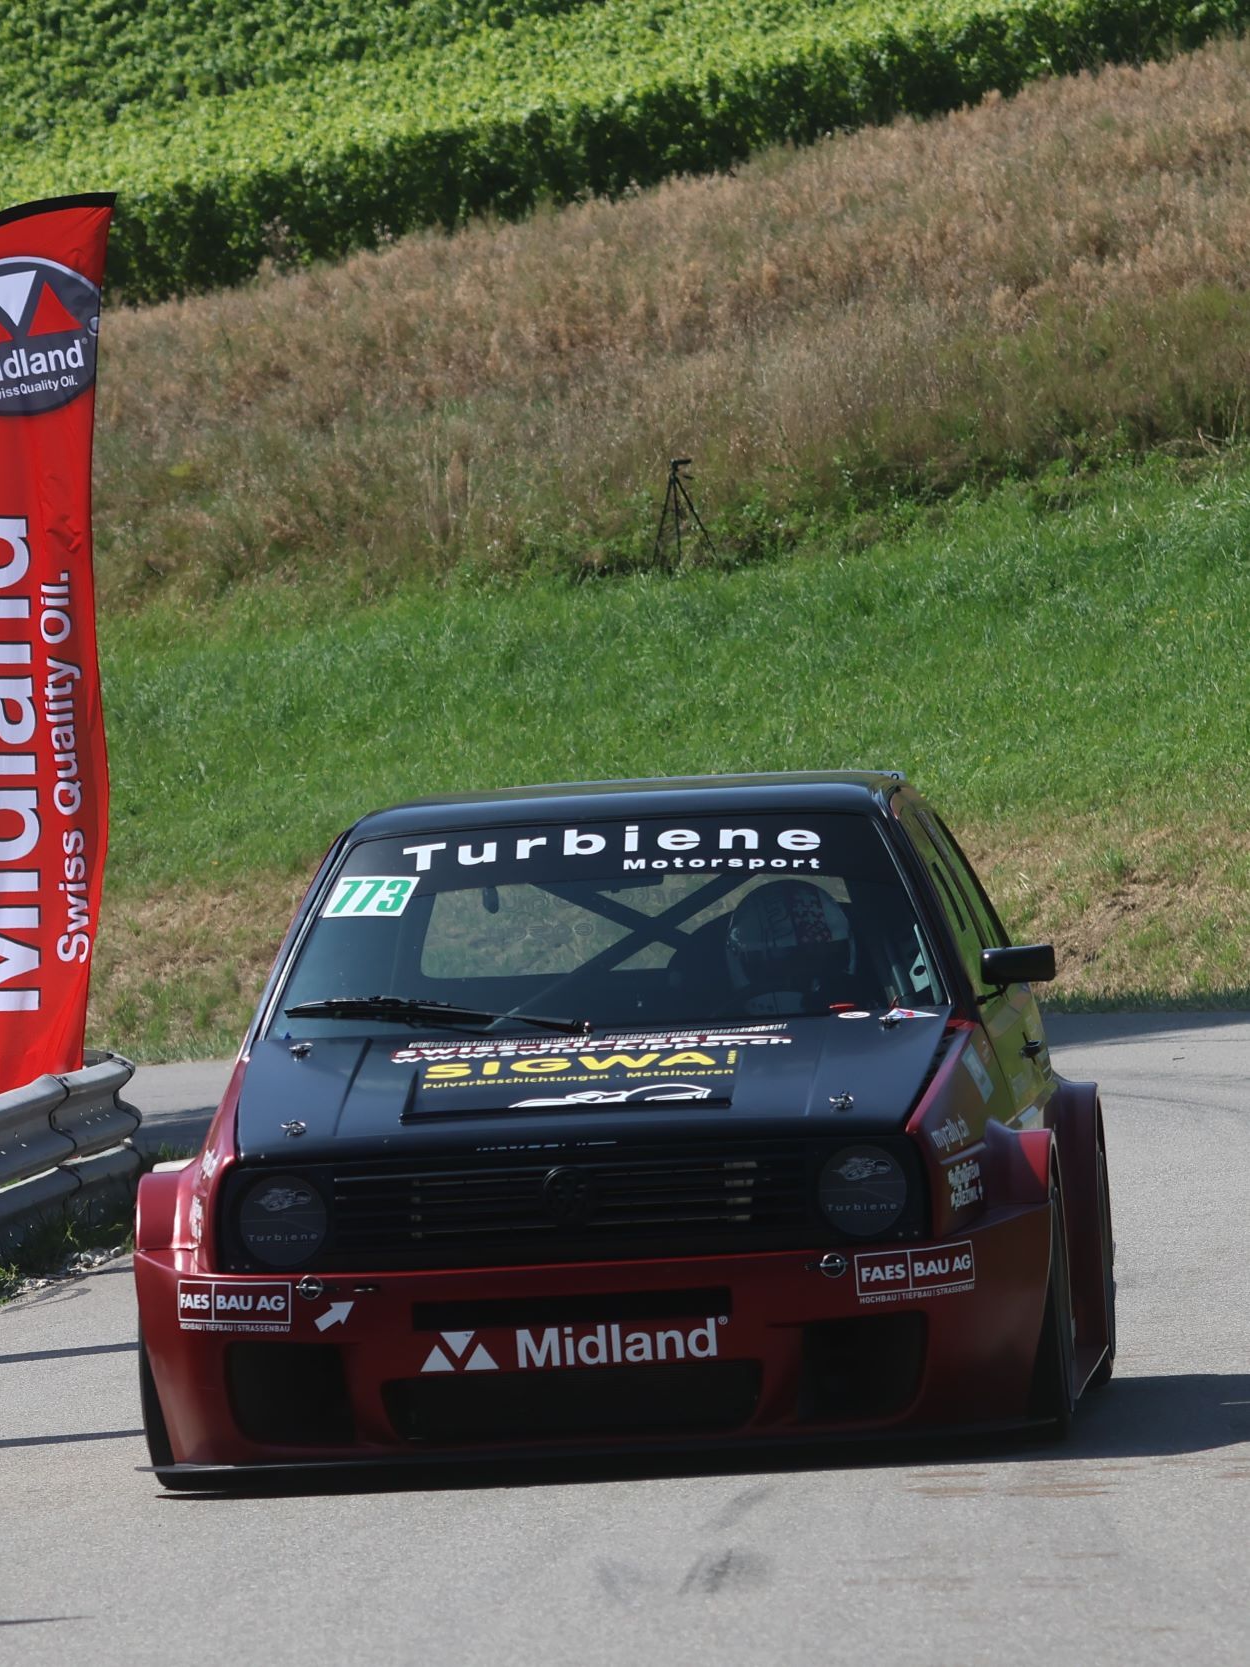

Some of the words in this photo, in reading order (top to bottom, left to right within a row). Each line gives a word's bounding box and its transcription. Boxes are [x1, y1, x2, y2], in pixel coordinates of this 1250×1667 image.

[19, 379, 59, 395] Quality
[60, 374, 78, 388] Oil.
[40, 571, 72, 645] Oil.
[44, 656, 82, 817] Quality
[402, 825, 822, 873] Turbiene
[622, 856, 822, 871] Motorsport
[56, 828, 90, 964] Swiss
[332, 878, 410, 914] 773
[424, 1051, 717, 1080] SIGWA
[422, 1073, 610, 1090] Pulverbeschichtungen
[626, 1068, 734, 1079] Metallwaren
[827, 1202, 898, 1212] Turbiene
[247, 1232, 319, 1242] Turbiene
[861, 1264, 906, 1283] FAES
[913, 1258, 950, 1277] BAU
[952, 1254, 971, 1272] AG
[180, 1293, 210, 1309] FAES
[216, 1295, 253, 1310] BAU
[256, 1295, 286, 1311] AG
[859, 1293, 898, 1304] HOCHBAU
[901, 1290, 933, 1300] TIEFBAU
[237, 1325, 290, 1333] STRASSENBAU
